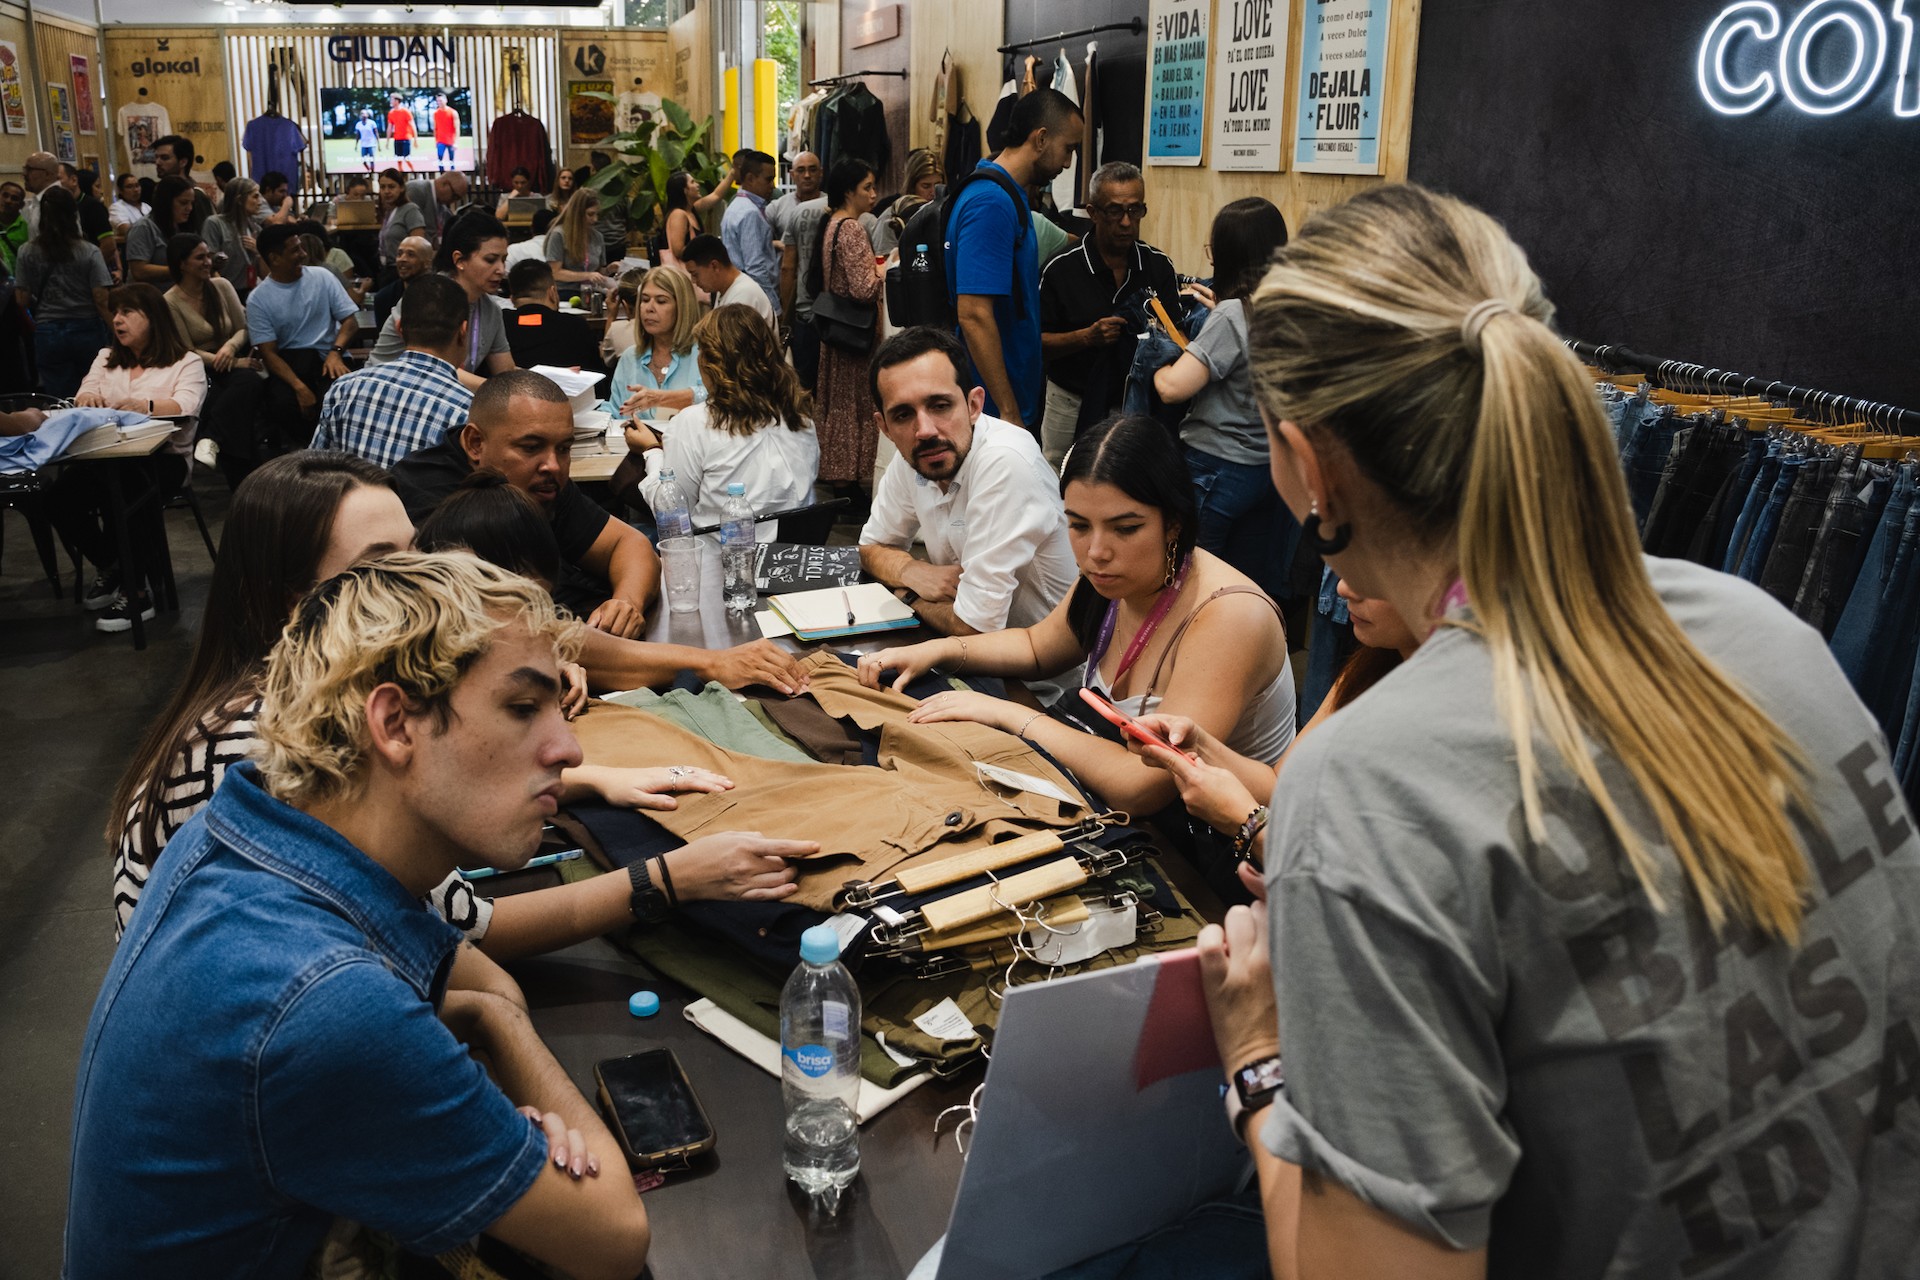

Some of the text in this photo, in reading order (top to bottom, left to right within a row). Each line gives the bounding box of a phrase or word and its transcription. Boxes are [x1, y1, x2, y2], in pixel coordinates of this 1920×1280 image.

[1163, 8, 1200, 42] VIDA
[1232, 0, 1273, 43] LOVE
[1317, 10, 1373, 24] Es como el agua
[1319, 28, 1367, 41] A veces Dulce
[328, 36, 455, 63] GILDAN
[1154, 40, 1205, 65] ES MAS BACANA
[1244, 47, 1254, 61] QUE
[1255, 44, 1275, 60] QUIERA
[1318, 49, 1367, 61] A veces salada
[131, 57, 200, 78] glokal
[1162, 67, 1193, 83] BAJO EL SOL
[1229, 68, 1269, 113] LOVE
[1309, 68, 1371, 99] DEJALA
[1161, 86, 1193, 101] BAILANDO
[1159, 104, 1192, 119] EN EL MAR
[1316, 102, 1360, 131] FLUIR
[1158, 123, 1190, 137] EN JEANS
[1244, 119, 1251, 132] EL
[1252, 118, 1271, 132] MUNDO
[1317, 142, 1337, 152] MACONDO
[806, 546, 825, 581] STENCIL
[1564, 738, 1914, 1040] BLE
[797, 1051, 832, 1065] brisa
[1621, 937, 1869, 1162] LAS
